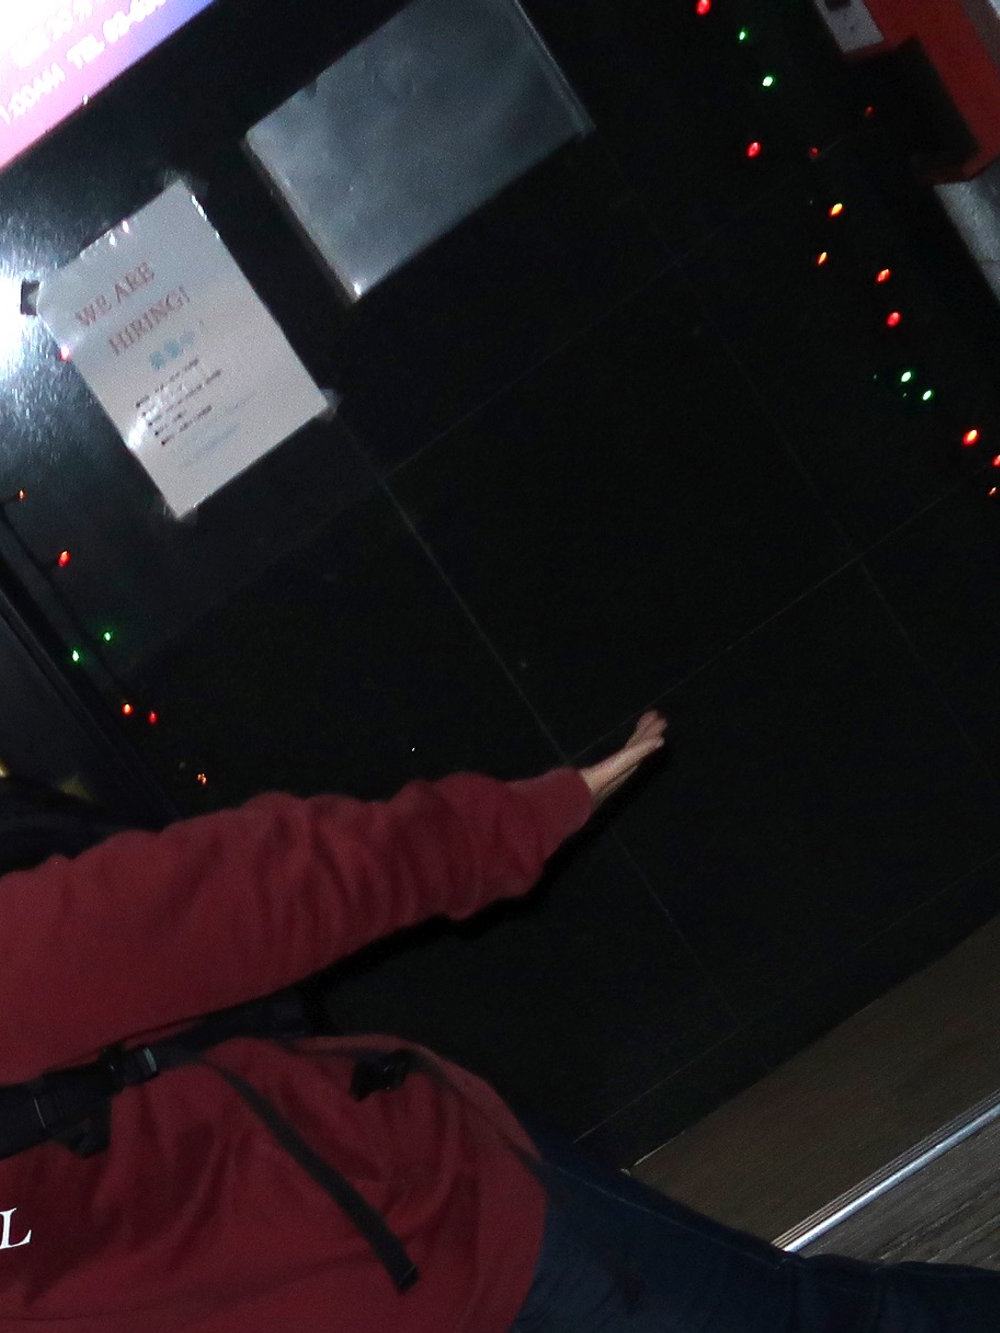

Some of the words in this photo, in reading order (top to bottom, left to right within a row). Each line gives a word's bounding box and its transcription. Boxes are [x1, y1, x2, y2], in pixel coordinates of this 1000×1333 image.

[75, 294, 113, 327] WE
[114, 261, 155, 304] ARE
[108, 286, 190, 357] HIRING!
